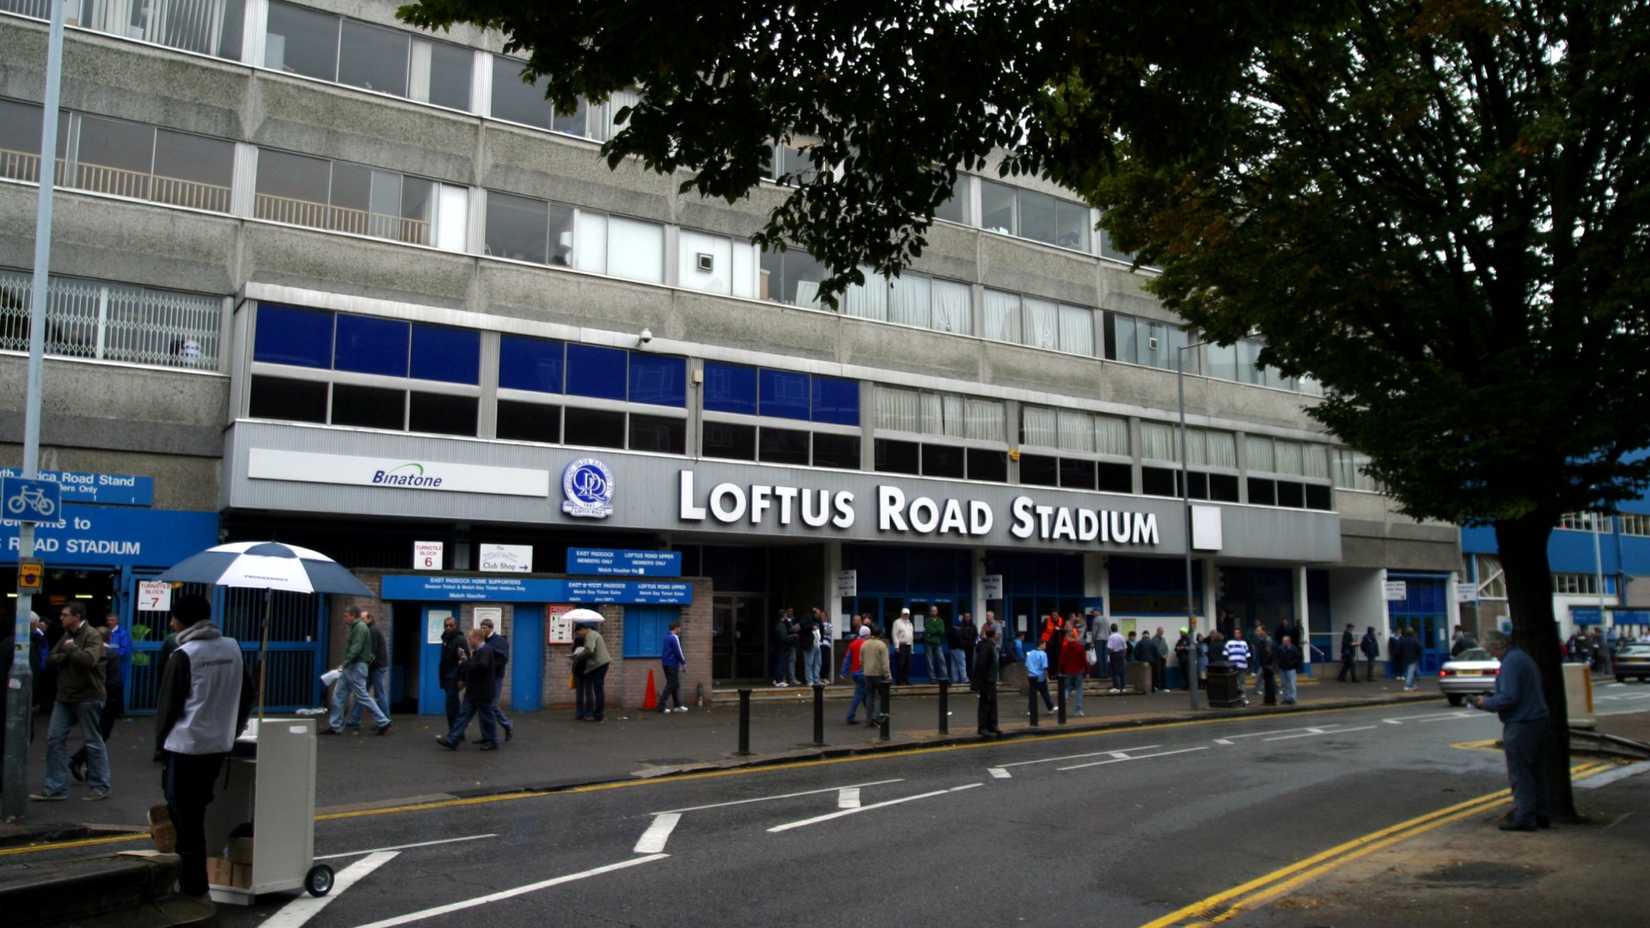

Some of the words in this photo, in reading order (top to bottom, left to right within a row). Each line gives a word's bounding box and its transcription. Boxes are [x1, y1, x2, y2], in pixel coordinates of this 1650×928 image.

[62, 472, 94, 484] Road
[98, 475, 136, 487] Stand
[372, 470, 443, 487] Binatone
[79, 485, 98, 494] Only
[680, 470, 855, 528] LOFTUS
[879, 485, 993, 535] ROAD
[1011, 496, 1160, 544] STADIUM
[74, 516, 91, 530] to
[8, 537, 59, 551] RAD
[66, 539, 141, 555] STADIUM
[425, 557, 432, 568] 6
[500, 562, 515, 570] Shop
[152, 597, 160, 608] 7
